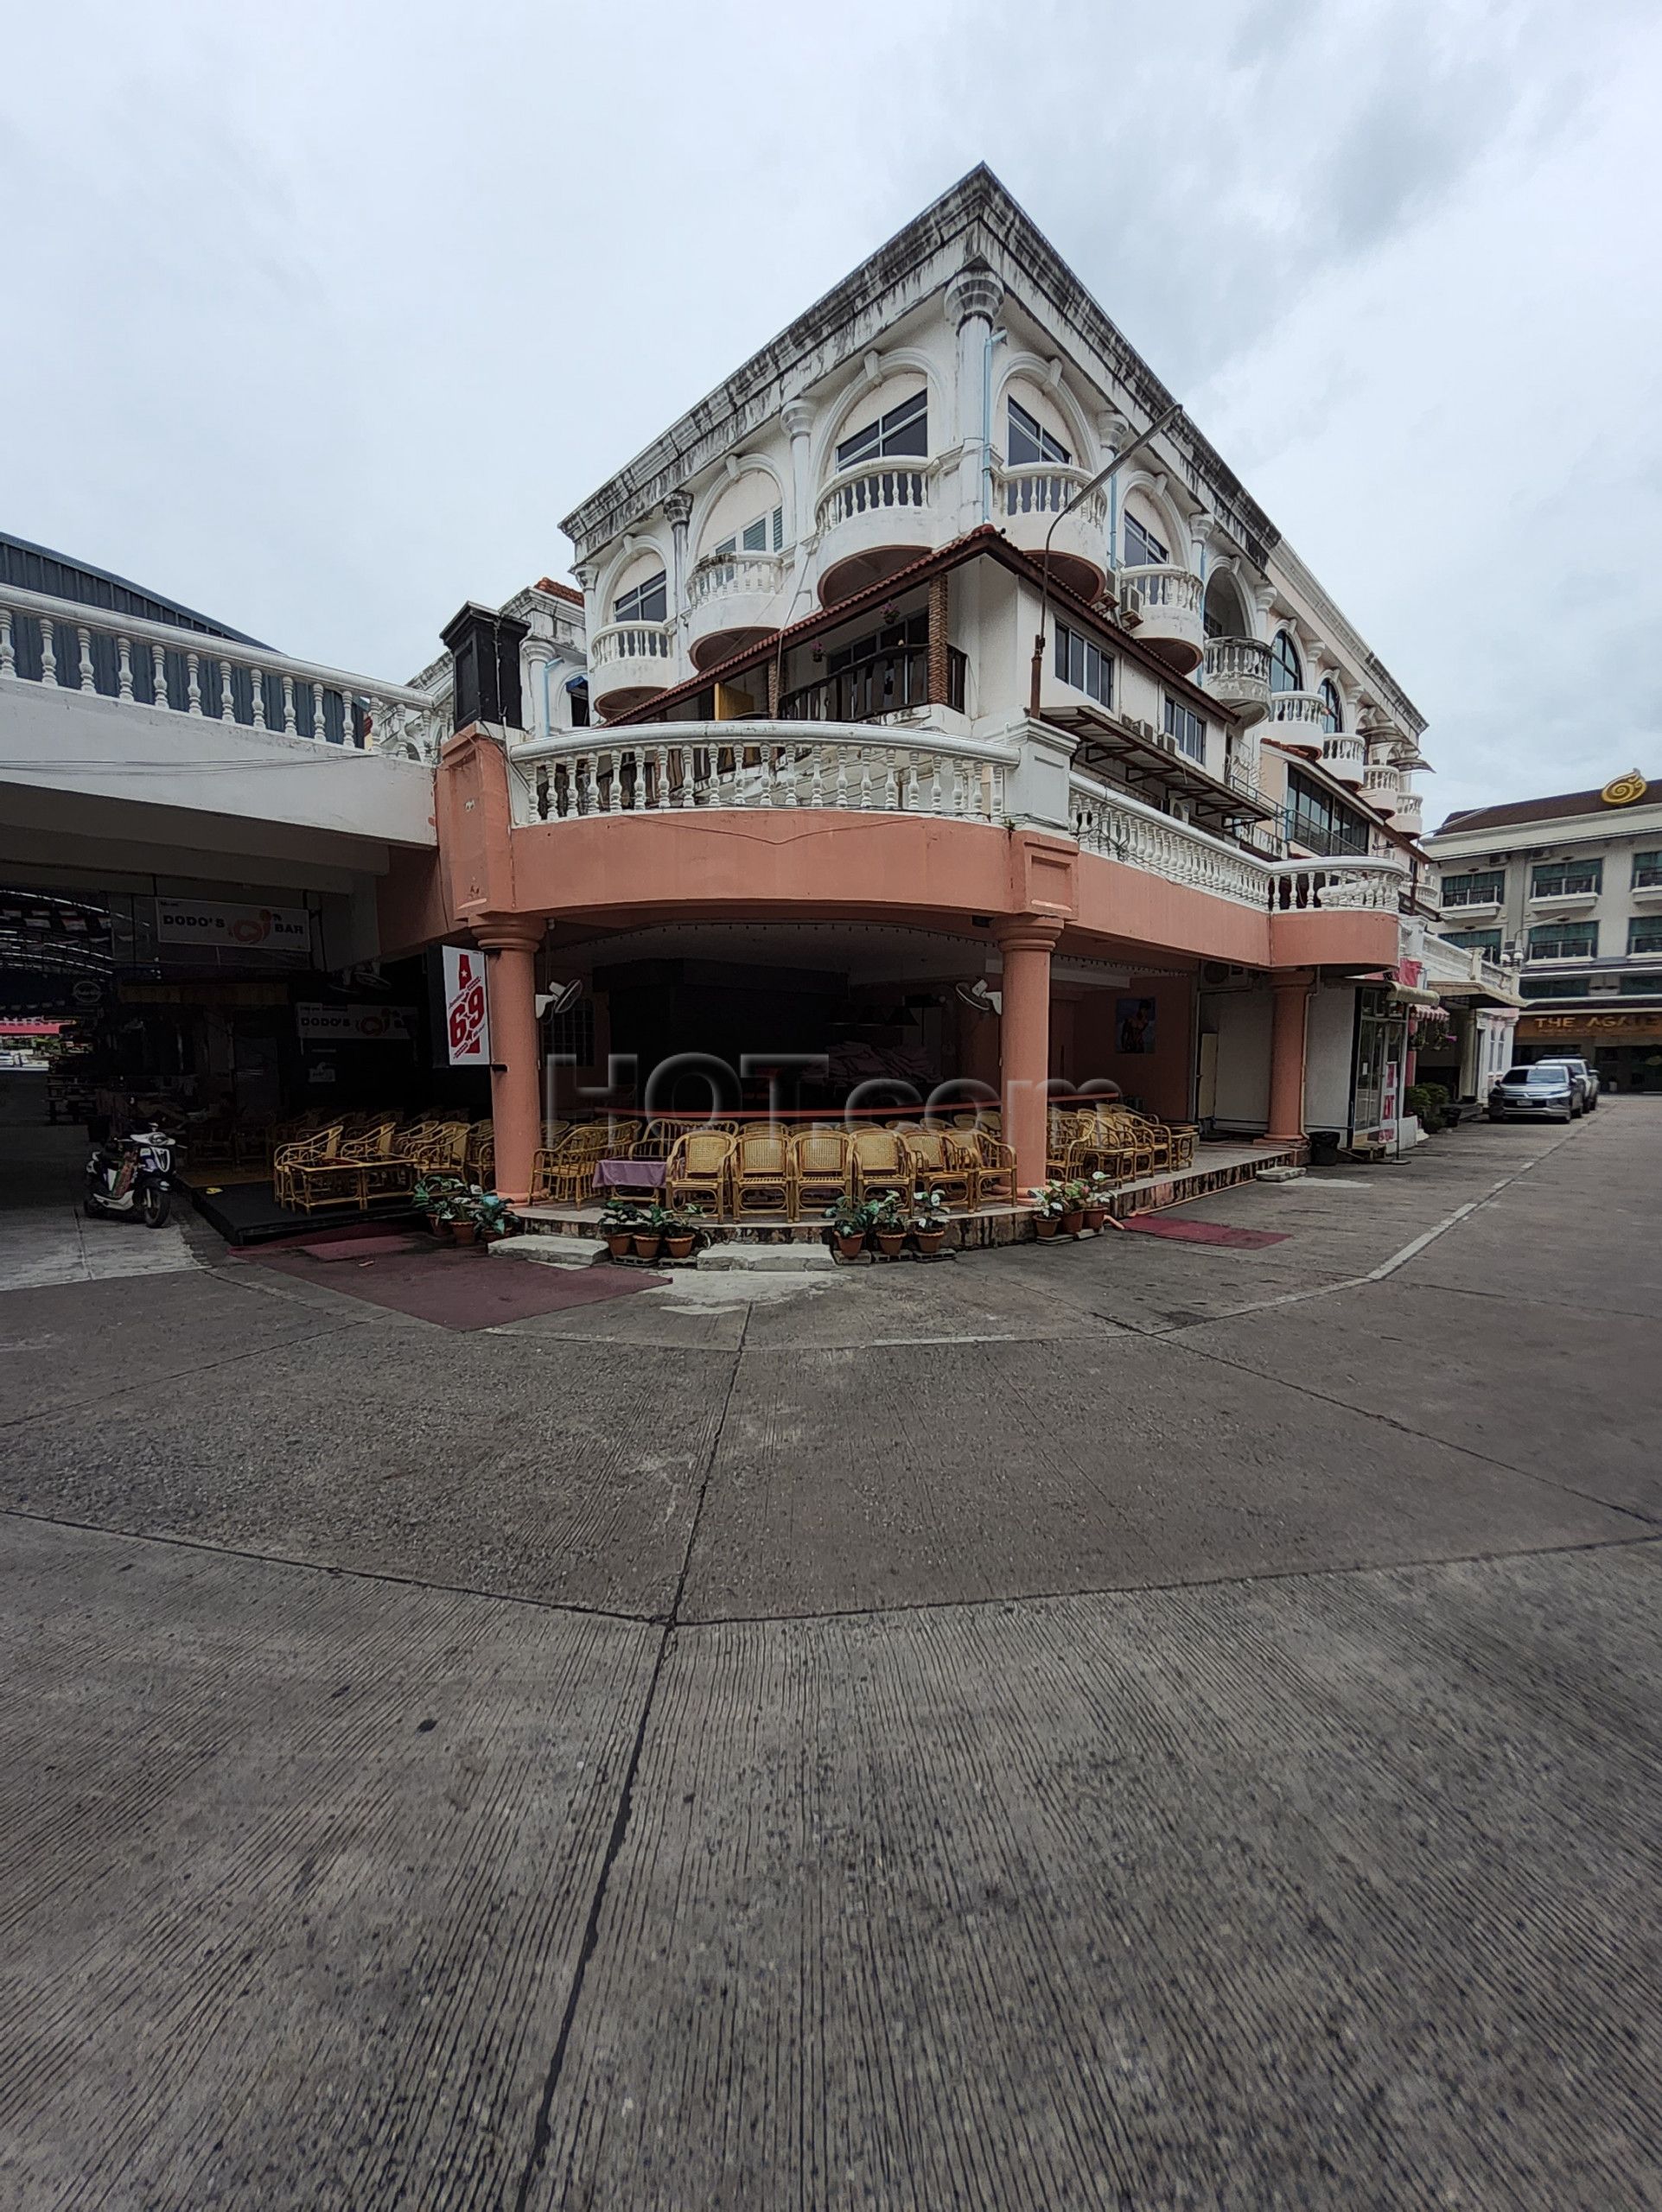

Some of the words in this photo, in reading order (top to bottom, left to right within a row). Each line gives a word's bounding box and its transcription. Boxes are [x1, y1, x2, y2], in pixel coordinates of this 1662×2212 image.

[162, 914, 226, 928] DODO'S
[274, 923, 304, 935] BAR
[1534, 1016, 1576, 1028] THE
